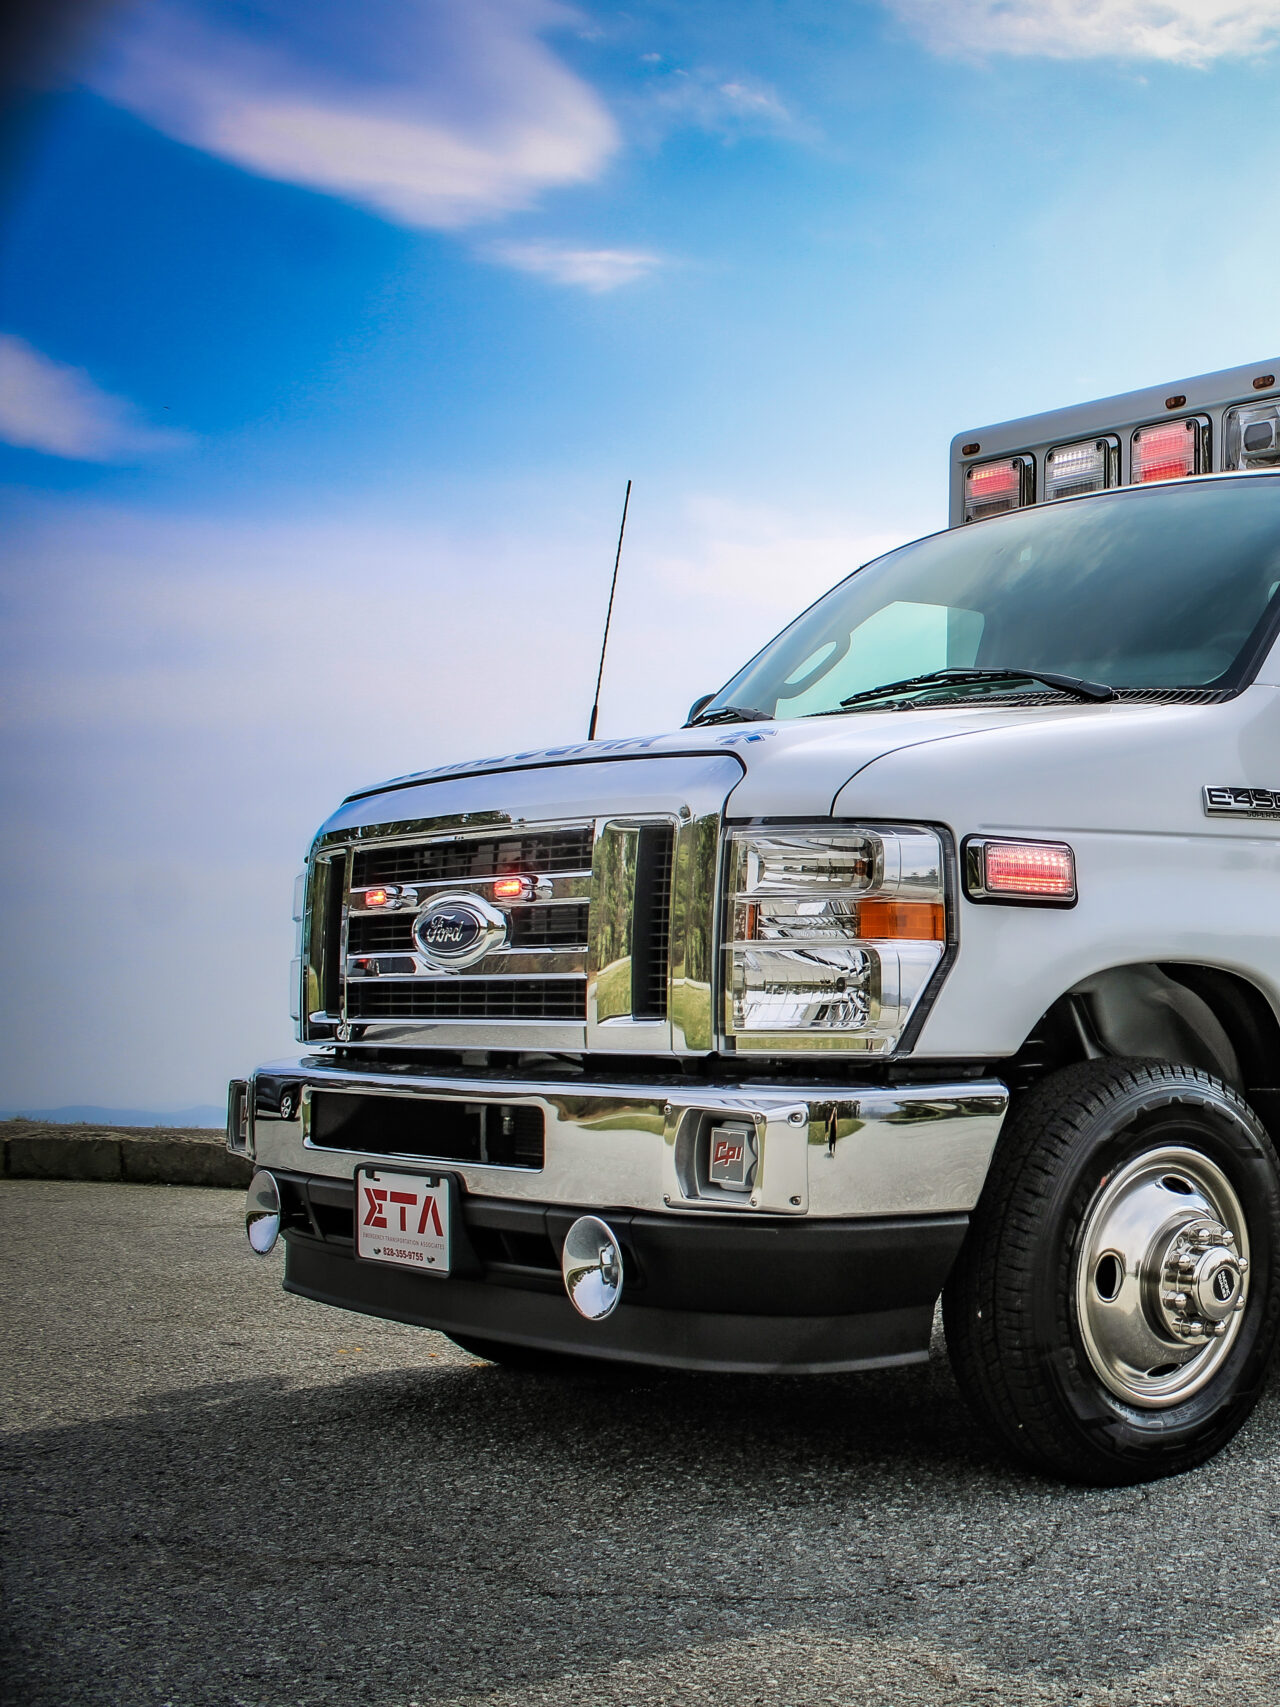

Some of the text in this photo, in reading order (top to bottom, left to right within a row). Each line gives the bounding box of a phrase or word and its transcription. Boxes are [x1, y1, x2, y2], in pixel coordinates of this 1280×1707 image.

[426, 914, 466, 943] Ford
[420, 1240, 445, 1250] ASSOCIATES
[382, 1246, 424, 1261] 828-355-9755
